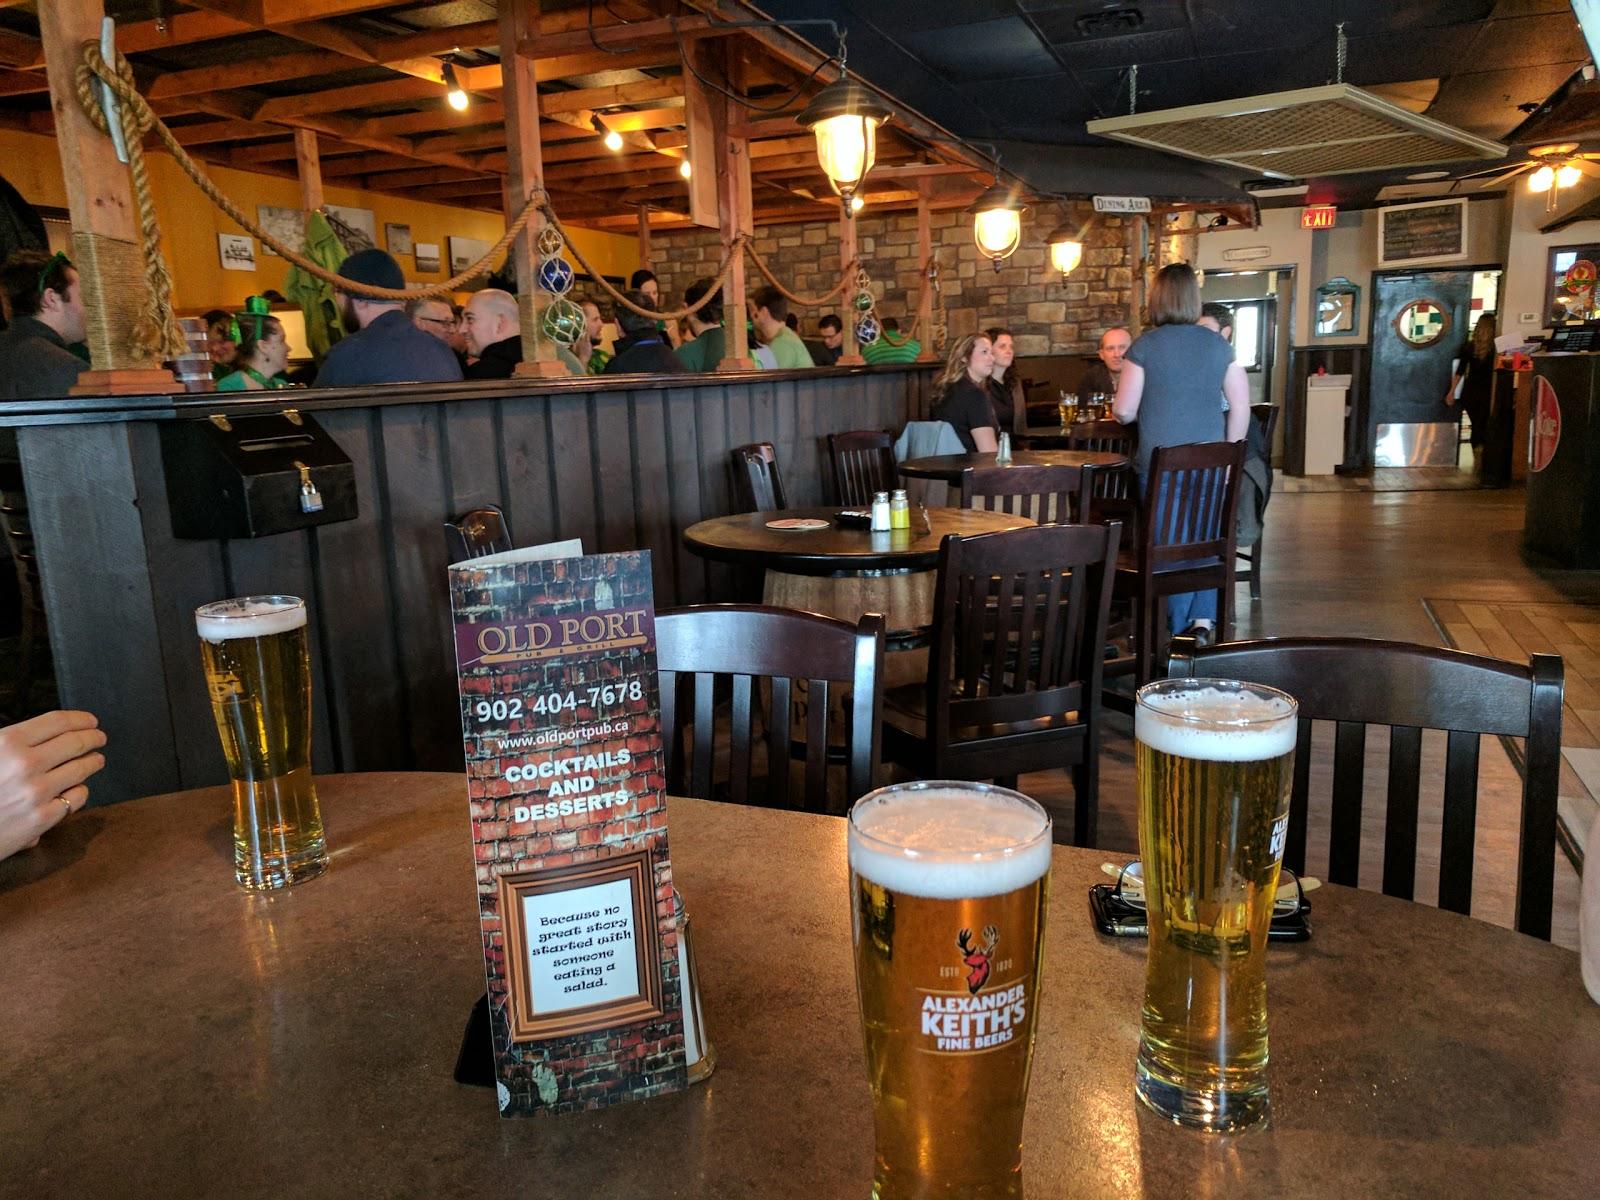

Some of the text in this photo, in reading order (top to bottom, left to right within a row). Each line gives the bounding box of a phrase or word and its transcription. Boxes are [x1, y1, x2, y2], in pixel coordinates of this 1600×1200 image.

[1303, 211, 1333, 227] EXIT
[477, 610, 647, 656] OLD PORT
[576, 642, 615, 651] GRILL
[477, 681, 643, 723] 902 404-7678
[497, 722, 629, 750] www.oldportpub.ca
[505, 748, 631, 783] COCKTAILS
[548, 776, 595, 798] AND
[514, 789, 629, 823] DESSERTS
[540, 905, 620, 927] Because no
[532, 930, 632, 956] started with
[538, 918, 628, 943] great story
[553, 949, 615, 968] someone
[554, 963, 616, 981] eating a
[563, 978, 608, 994] salad.
[922, 984, 1025, 1013] ALEXANDER
[921, 999, 1026, 1037] KEITH'S
[937, 1028, 1013, 1050] FINE BEERS
